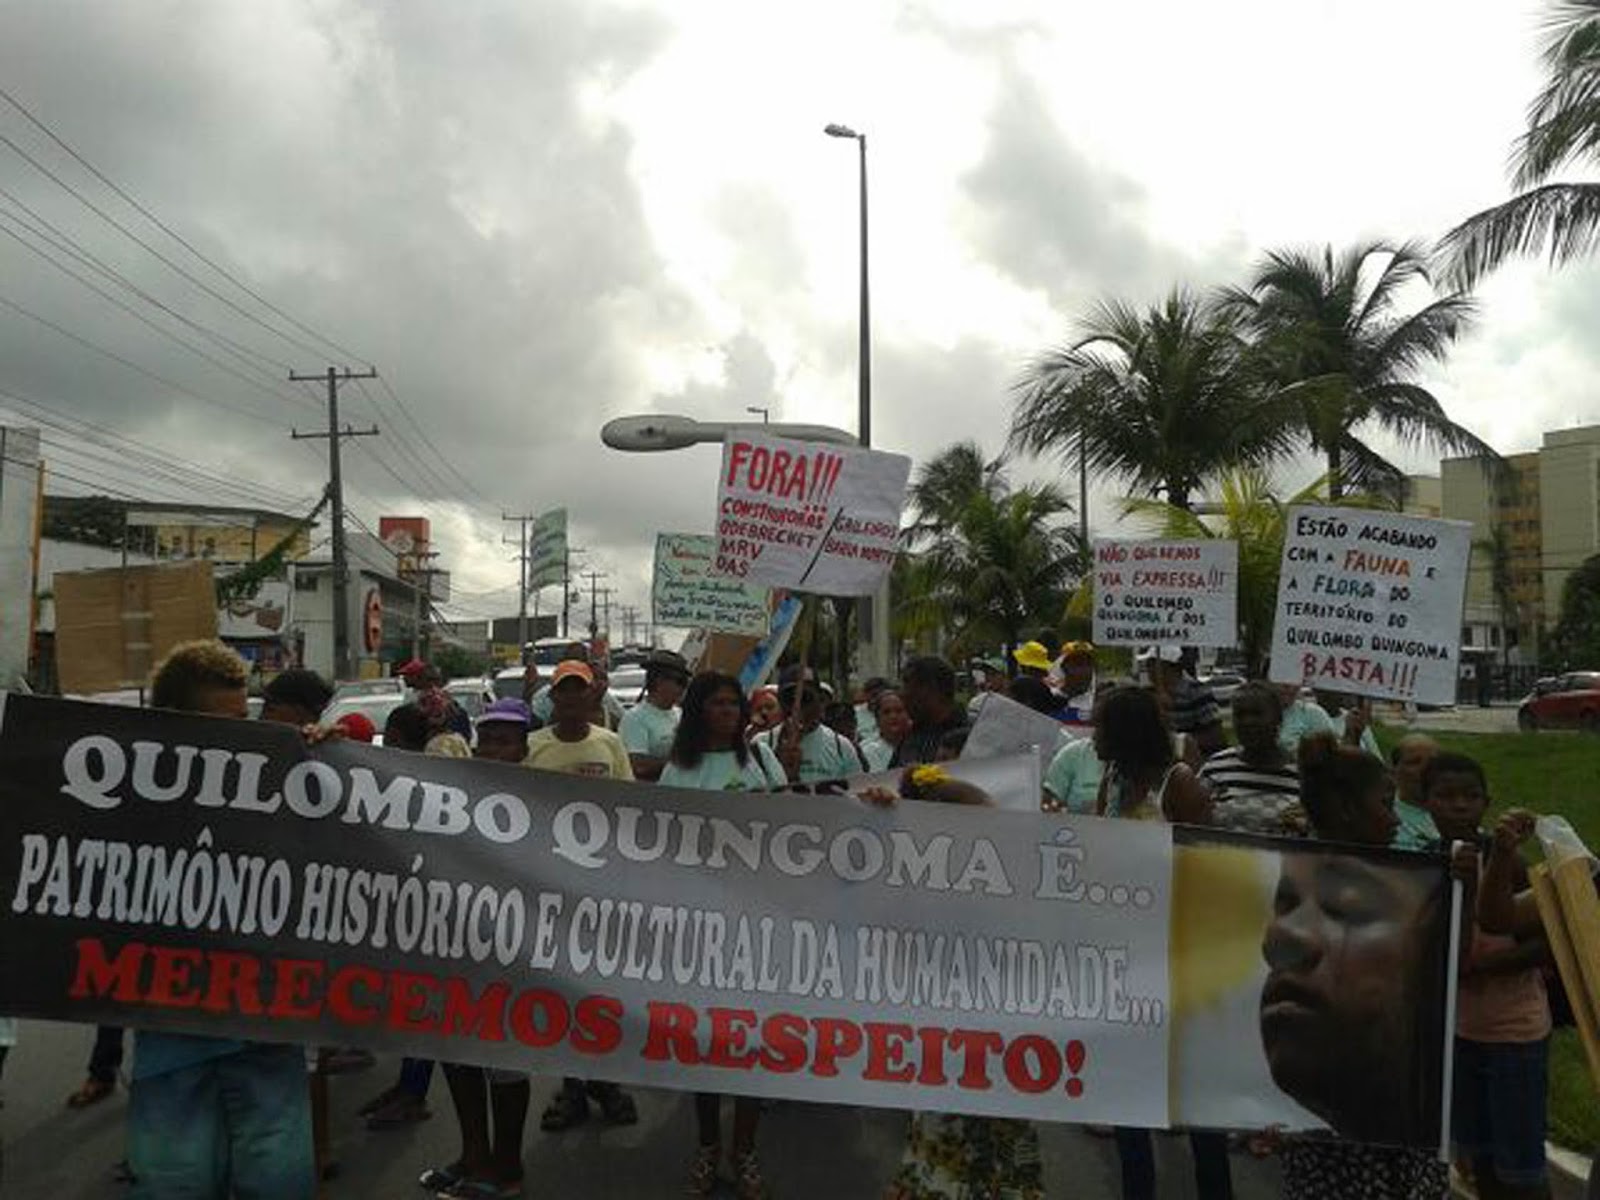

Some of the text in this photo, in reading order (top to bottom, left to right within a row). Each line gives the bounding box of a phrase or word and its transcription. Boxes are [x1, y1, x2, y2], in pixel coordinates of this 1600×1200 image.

[726, 441, 843, 512] FORA!!!
[1296, 516, 1437, 549] ESTÃO ACABANDO
[719, 538, 764, 560] MRV
[1099, 543, 1127, 562] NÃO
[1287, 547, 1319, 563] COM
[1344, 550, 1411, 577] FAUNA
[716, 556, 749, 578] OAS
[1099, 571, 1123, 587] VIA
[1104, 594, 1113, 607] O
[1287, 575, 1411, 601] A FLORA DO
[1183, 612, 1206, 626] DOS
[1286, 602, 1374, 624] TERRITÓRIO
[1287, 627, 1449, 660] QUILOMBO QUINGOMA
[1302, 652, 1418, 697] BASTA!!!
[60, 735, 1155, 907] QUILOMBO QUINGOMA É...
[12, 827, 1164, 1028] PATRIMÔNIO HISTÓRICO E CULTURAL DA HUMANIDADE...
[70, 938, 1086, 1099] MERECEMOS RESPEITO!
